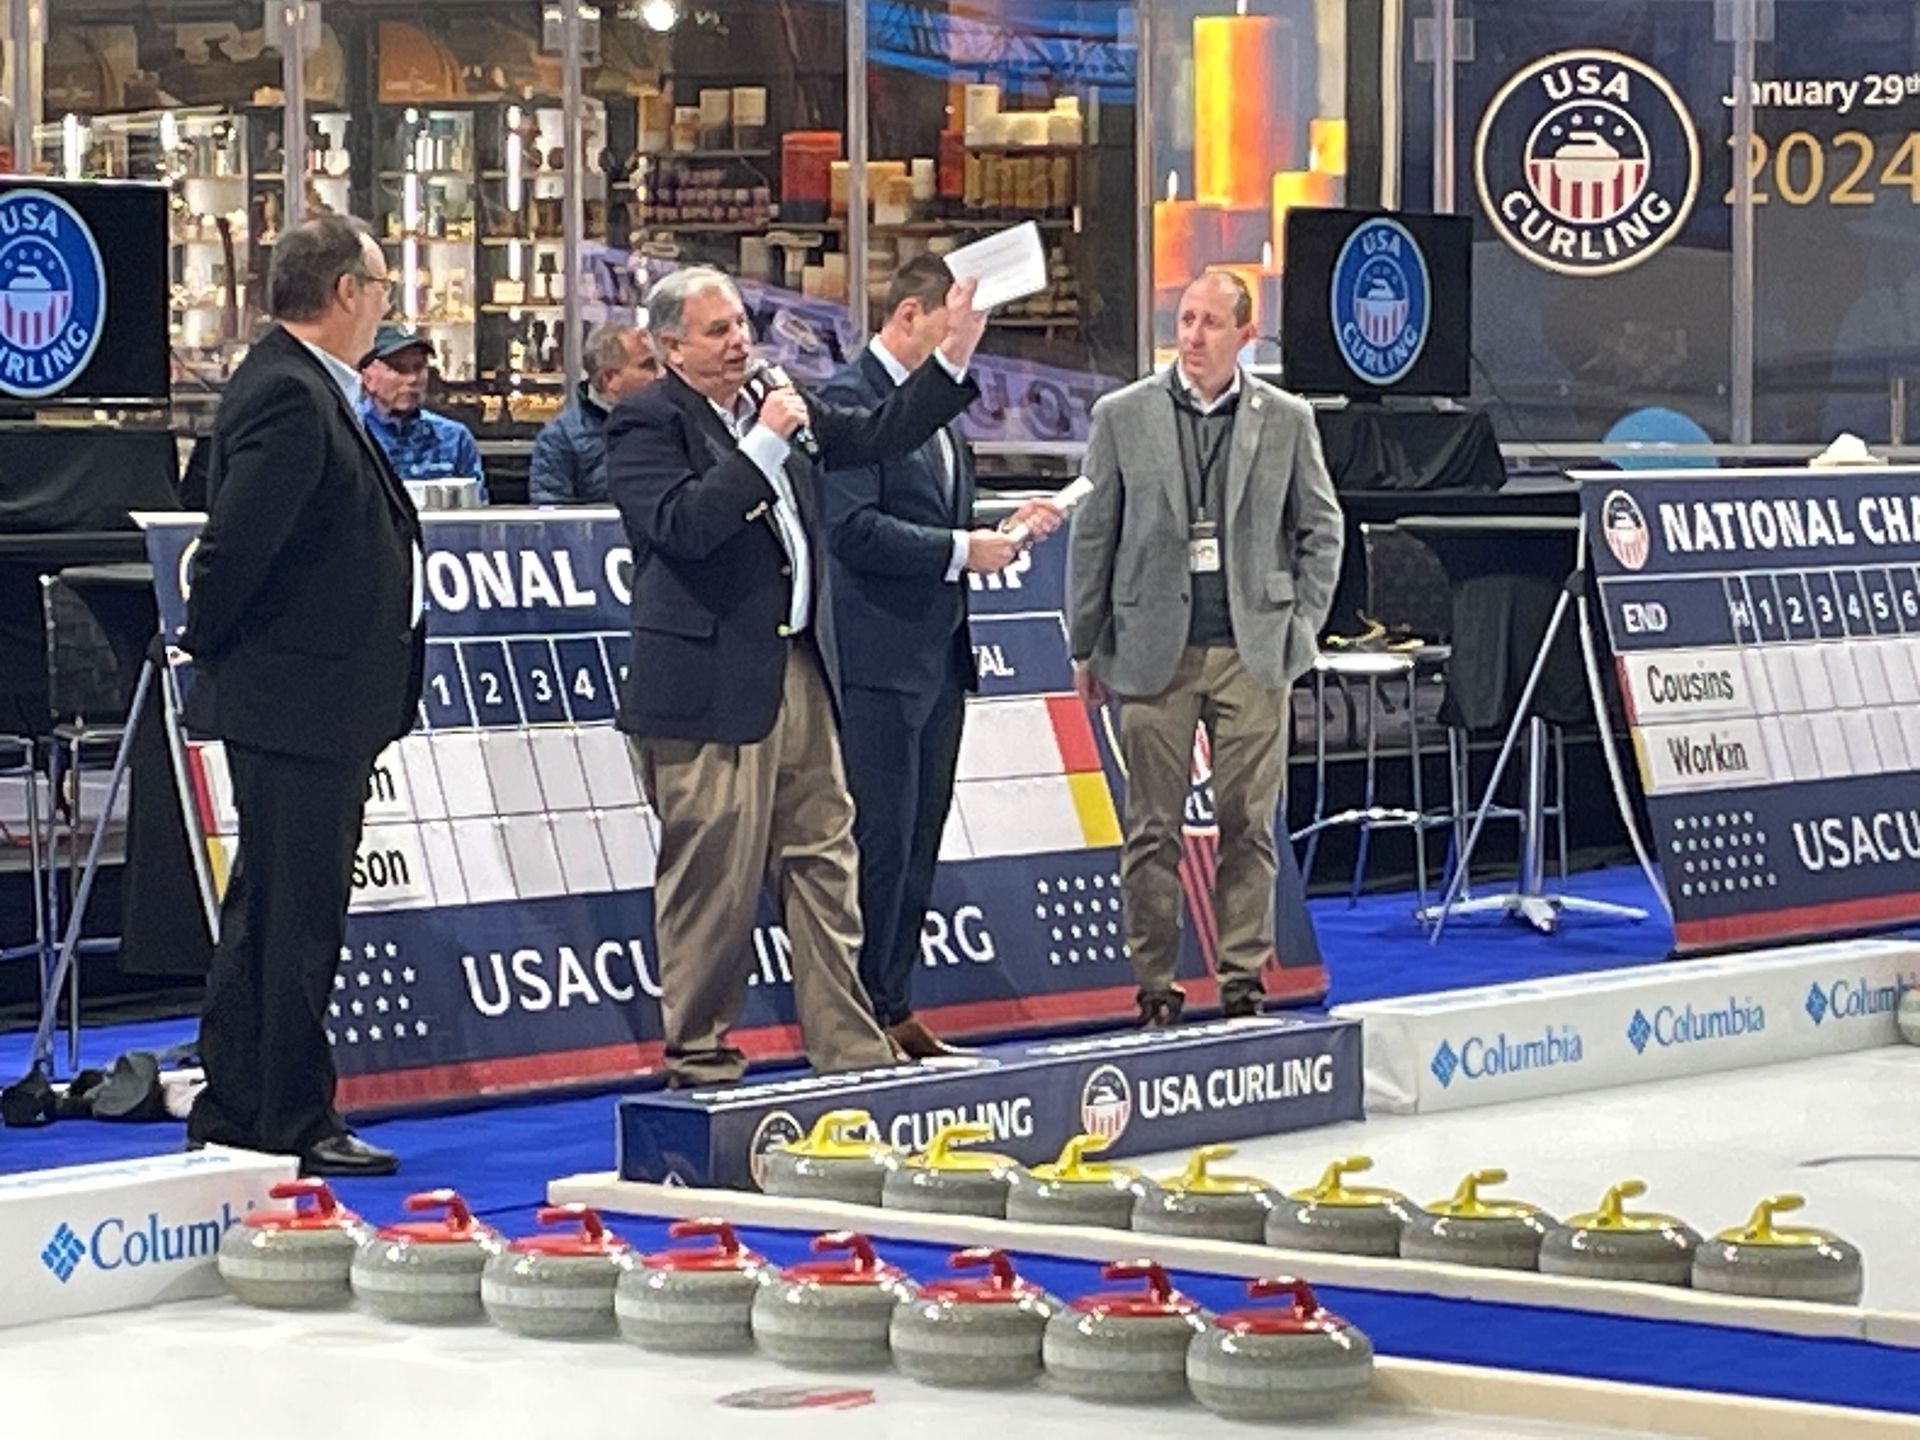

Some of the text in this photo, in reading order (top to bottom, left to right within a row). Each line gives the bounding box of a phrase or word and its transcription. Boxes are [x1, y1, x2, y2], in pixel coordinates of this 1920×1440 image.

[1541, 65, 1630, 102] USA
[1725, 129, 1920, 205] 2024
[0, 203, 59, 238] USA
[1362, 229, 1401, 258] USA
[1502, 190, 1672, 260] CURLING
[1343, 322, 1418, 375] CURLING
[1659, 499, 1855, 552] NATIONAL
[1622, 603, 1668, 632] END
[1759, 599, 1773, 625] 1
[1786, 596, 1804, 623] 2
[1817, 595, 1833, 622] 3
[1848, 594, 1861, 620] 4
[1871, 592, 1889, 618] 5
[1902, 590, 1918, 616] 6
[432, 668, 595, 706] 1 2 3 4
[1648, 661, 1733, 702] Cousins
[1668, 732, 1749, 775] Workin
[1793, 810, 1920, 870] USACU
[1654, 996, 1765, 1047] Columbia
[1461, 1024, 1583, 1080] Columbia
[1139, 1055, 1333, 1119] USA CURLING
